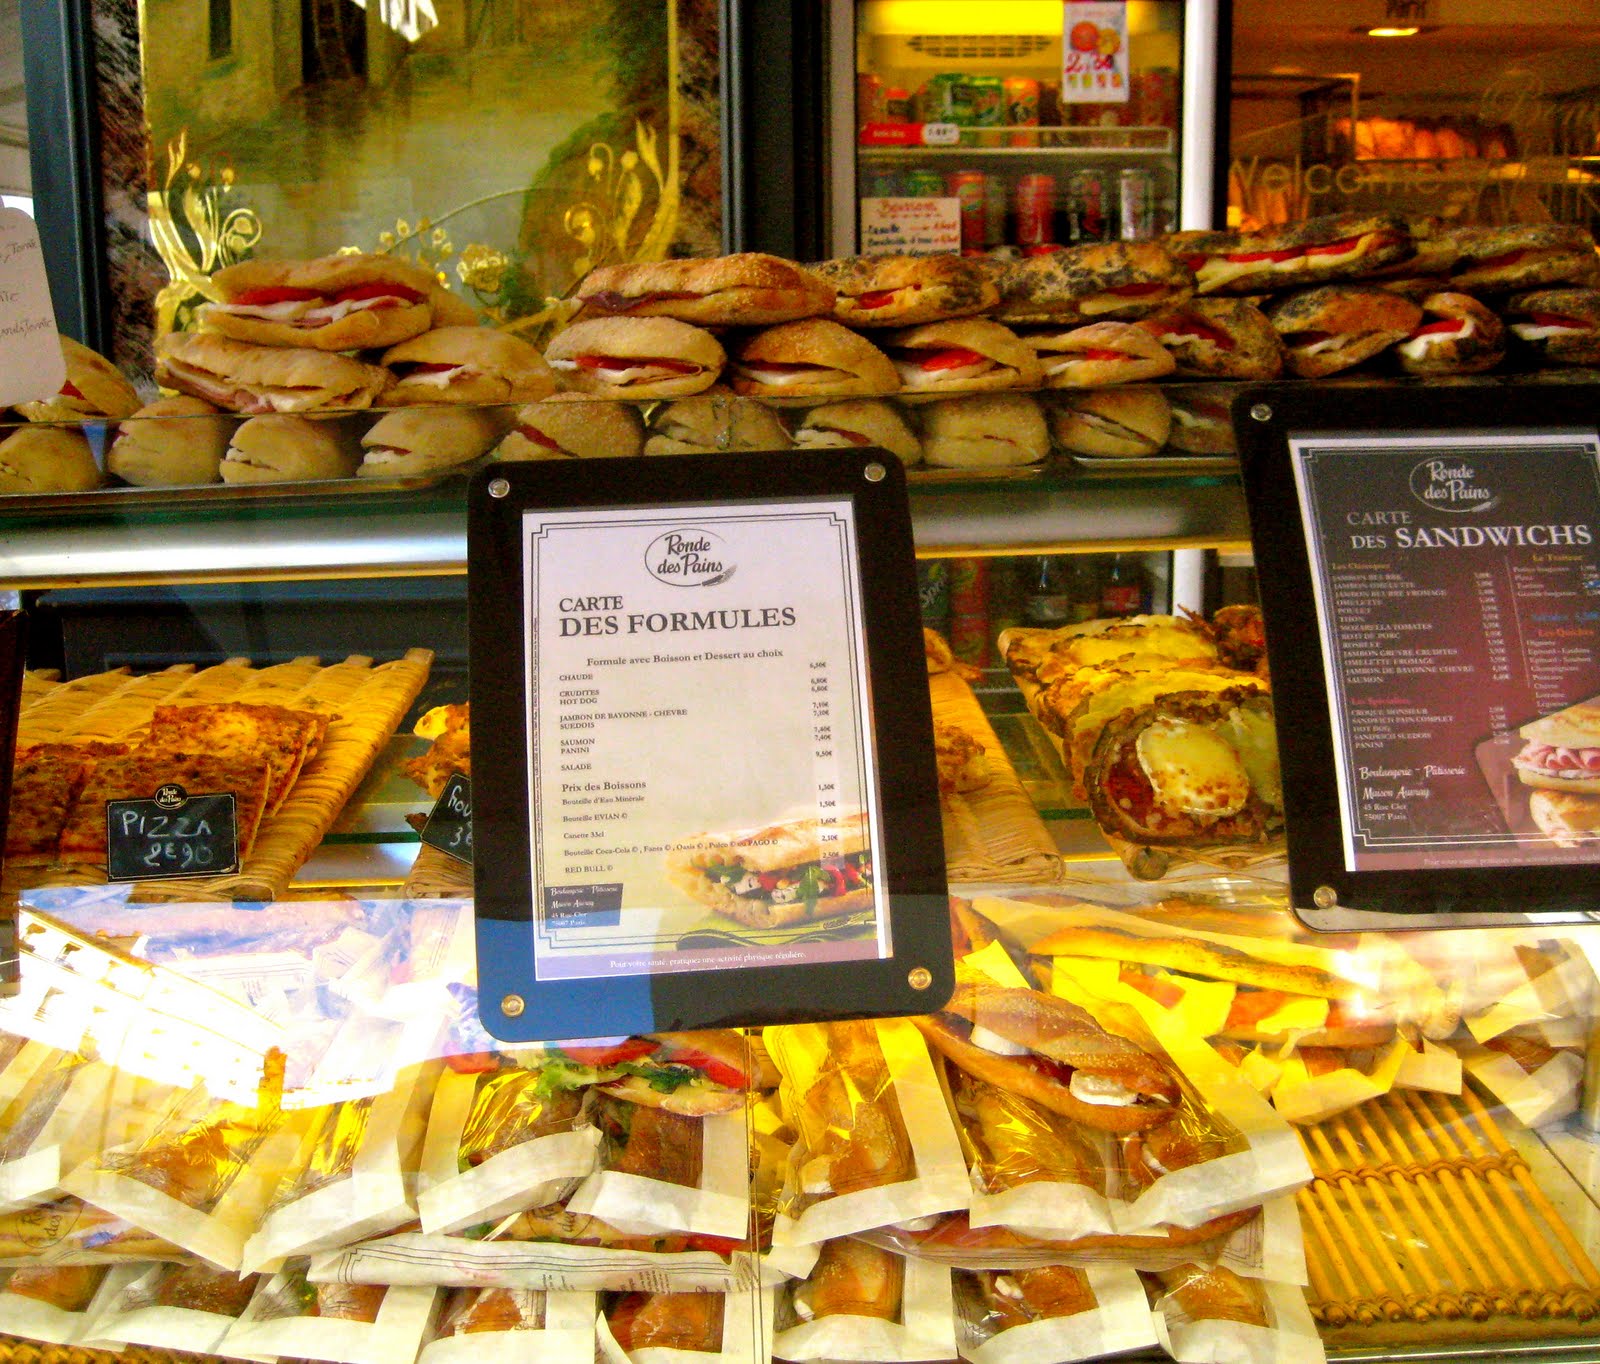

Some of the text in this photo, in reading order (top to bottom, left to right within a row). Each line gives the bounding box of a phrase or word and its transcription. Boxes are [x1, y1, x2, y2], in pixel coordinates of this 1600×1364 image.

[1426, 461, 1475, 482] Ronde
[1424, 479, 1491, 502] des Pains
[1346, 511, 1412, 525] CARTE
[1351, 524, 1593, 549] DES SANDWICHS
[664, 534, 712, 556] Ronde
[657, 553, 723, 576] des Pains
[559, 595, 624, 613] CARTE
[559, 606, 797, 637] DES FORMULES
[587, 649, 784, 667] Formule avec Boisson et Dessert au choix
[559, 673, 594, 682] CHAUDE
[1345, 667, 1382, 676] JAMBON
[559, 689, 600, 698] CRUDITES
[560, 697, 598, 706] HOT DOG
[560, 708, 689, 723] JAMBON DE BAYONNE CHEVRE
[560, 722, 595, 730] SUEDOIS
[560, 738, 596, 747] SAUMON
[560, 746, 590, 755] PANINI
[561, 763, 592, 772] SALADE
[1359, 764, 1466, 781] Boulangerie Pâtisserie
[562, 780, 647, 793] Prix des Boissons
[1362, 786, 1394, 801] Maison
[562, 798, 592, 806] Bouteille
[562, 815, 593, 823] Bouteille
[594, 813, 620, 821] EVIAN
[1387, 811, 1407, 821] Paris
[563, 831, 604, 840] Canette 33cl
[564, 849, 594, 857] Bouteille
[595, 847, 631, 856] Coca-Cola
[643, 845, 663, 853] Fanta
[676, 843, 696, 851] Oasis
[748, 839, 770, 847] PAGO
[565, 866, 582, 874] RED
[584, 865, 606, 873] BULL
[610, 960, 628, 969] Pour
[628, 959, 646, 968] votre
[669, 957, 701, 967] pratiquez
[718, 954, 743, 964] activité
[744, 953, 774, 964] physique
